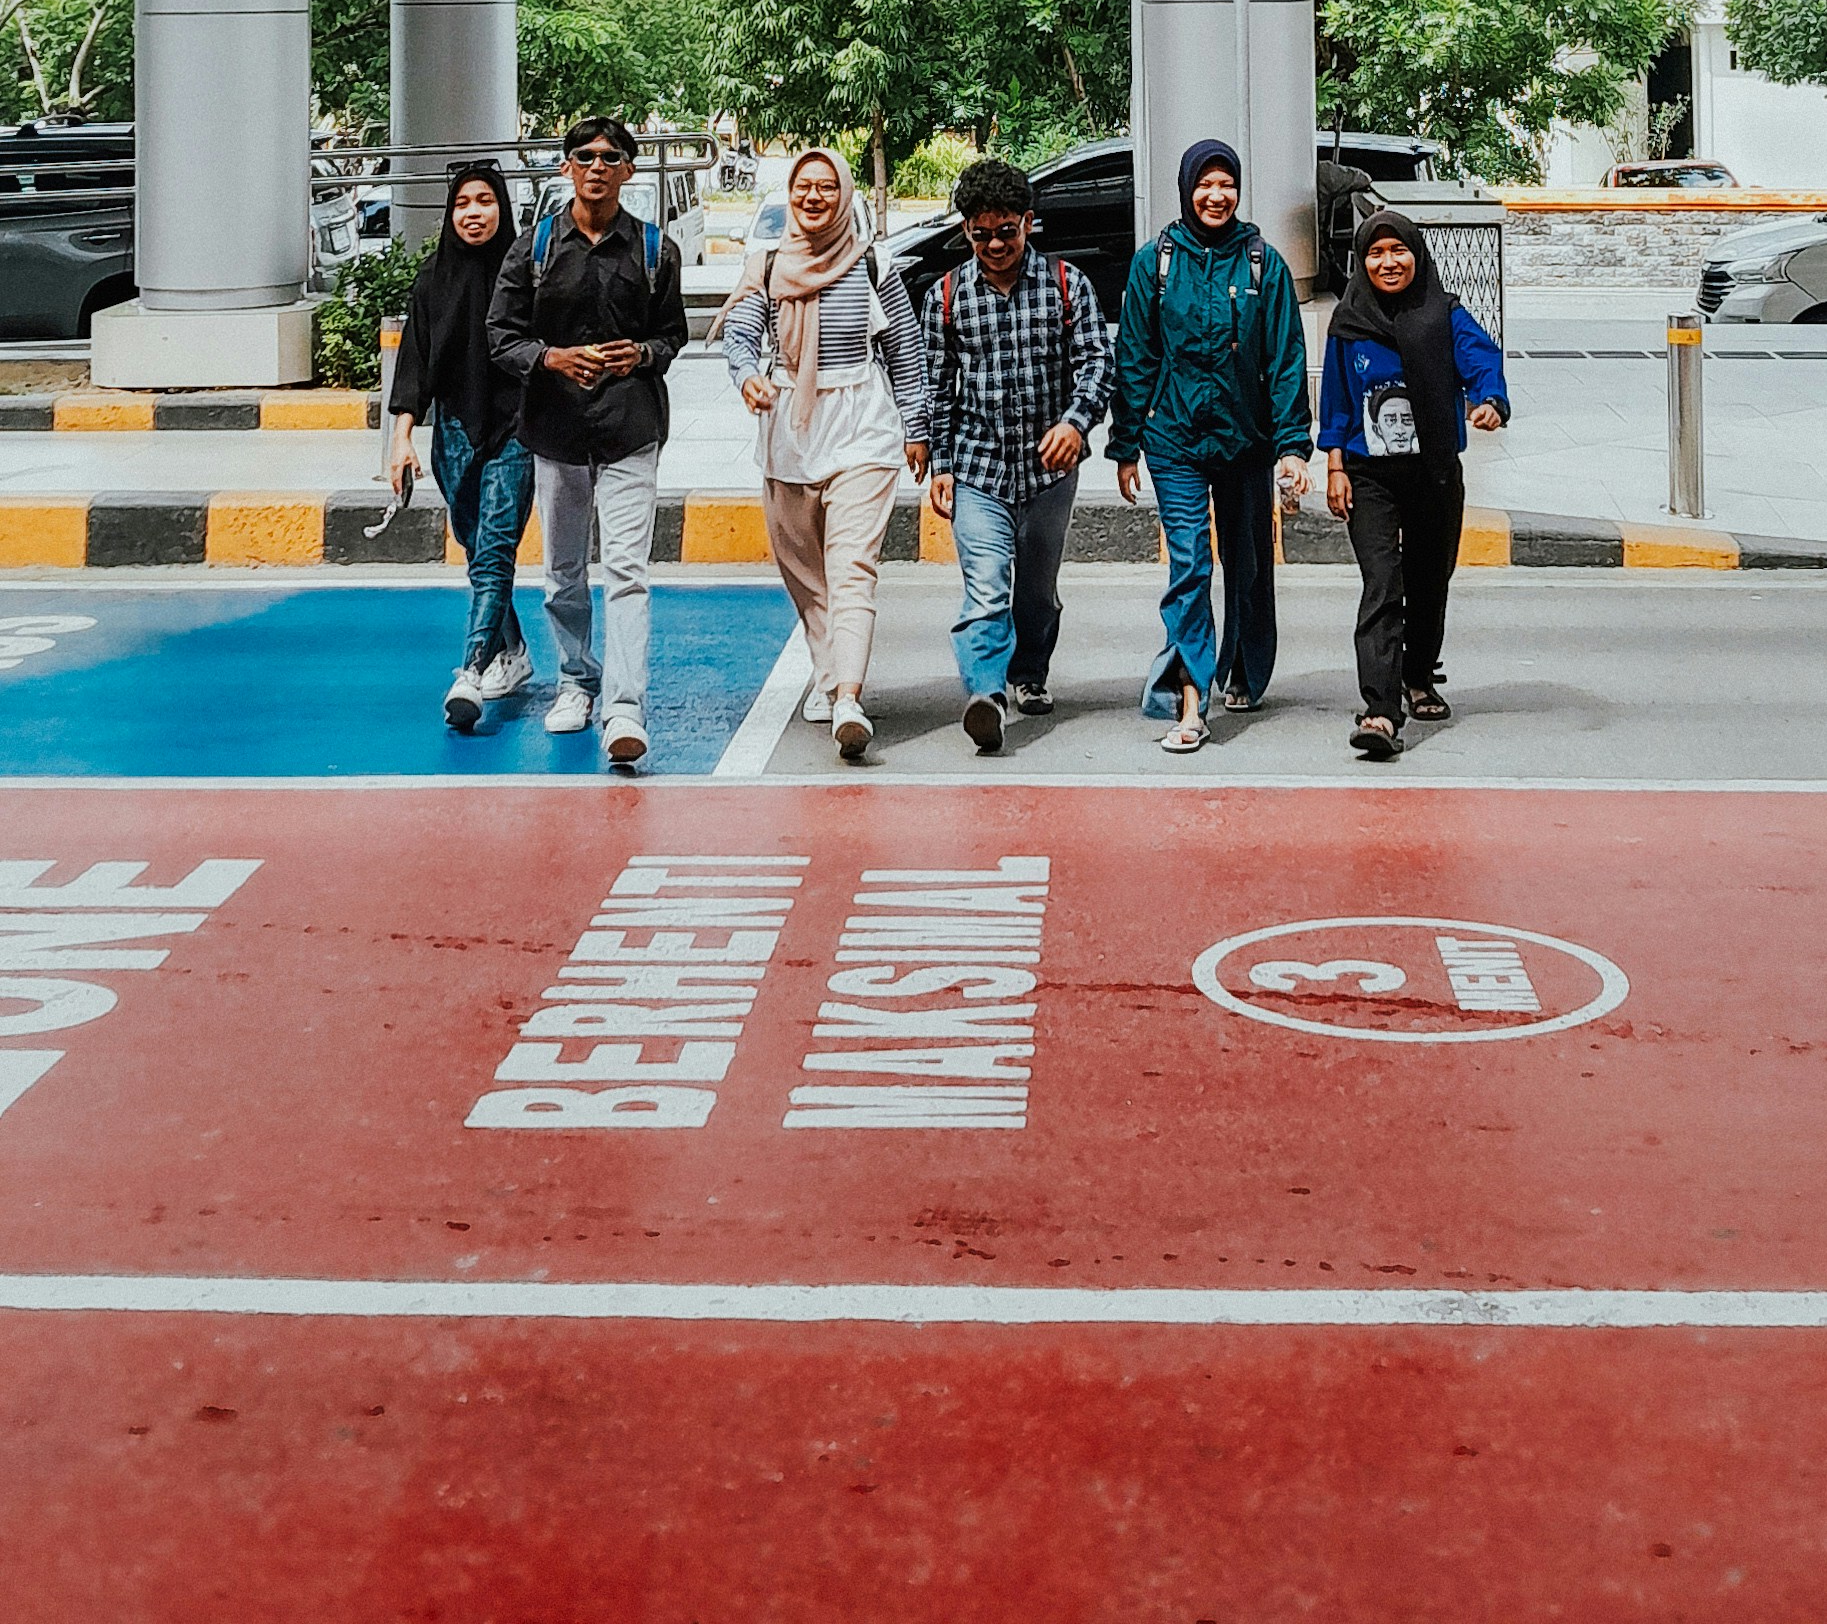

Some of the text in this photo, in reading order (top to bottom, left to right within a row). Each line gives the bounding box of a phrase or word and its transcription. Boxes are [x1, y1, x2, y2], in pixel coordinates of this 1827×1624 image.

[463, 855, 811, 1129] BERHENTI
[782, 856, 1050, 1129] MAKSIMAL
[1248, 959, 1407, 994] 3
[1434, 935, 1543, 1012] MENIT
